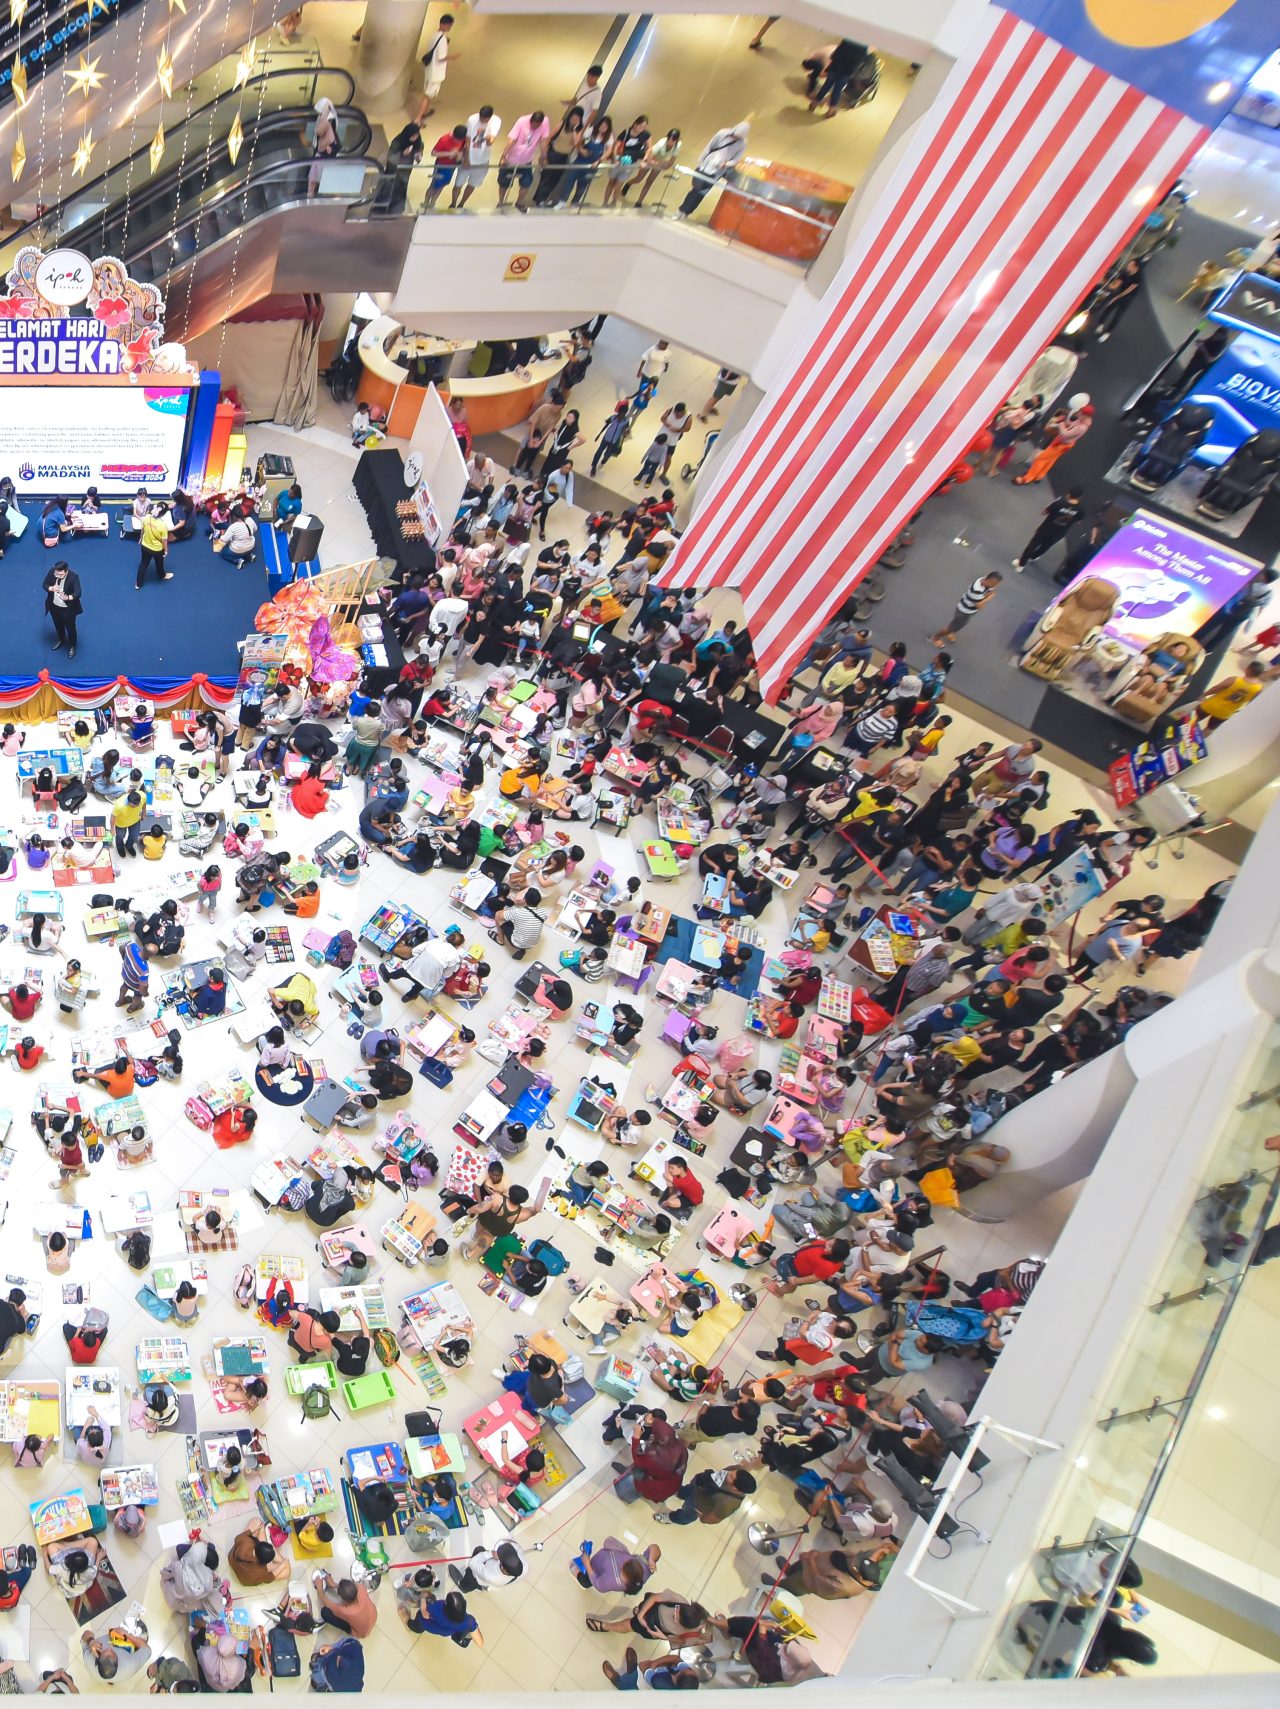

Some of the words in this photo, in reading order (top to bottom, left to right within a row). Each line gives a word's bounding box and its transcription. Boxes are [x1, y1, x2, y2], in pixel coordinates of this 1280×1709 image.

[66, 320, 105, 338] HARI
[38, 470, 91, 478] MADANI
[1132, 546, 1169, 567] Among
[1168, 561, 1196, 578] Them
[1192, 574, 1213, 585] All
[1153, 542, 1174, 557] The
[1172, 552, 1206, 571] Master
